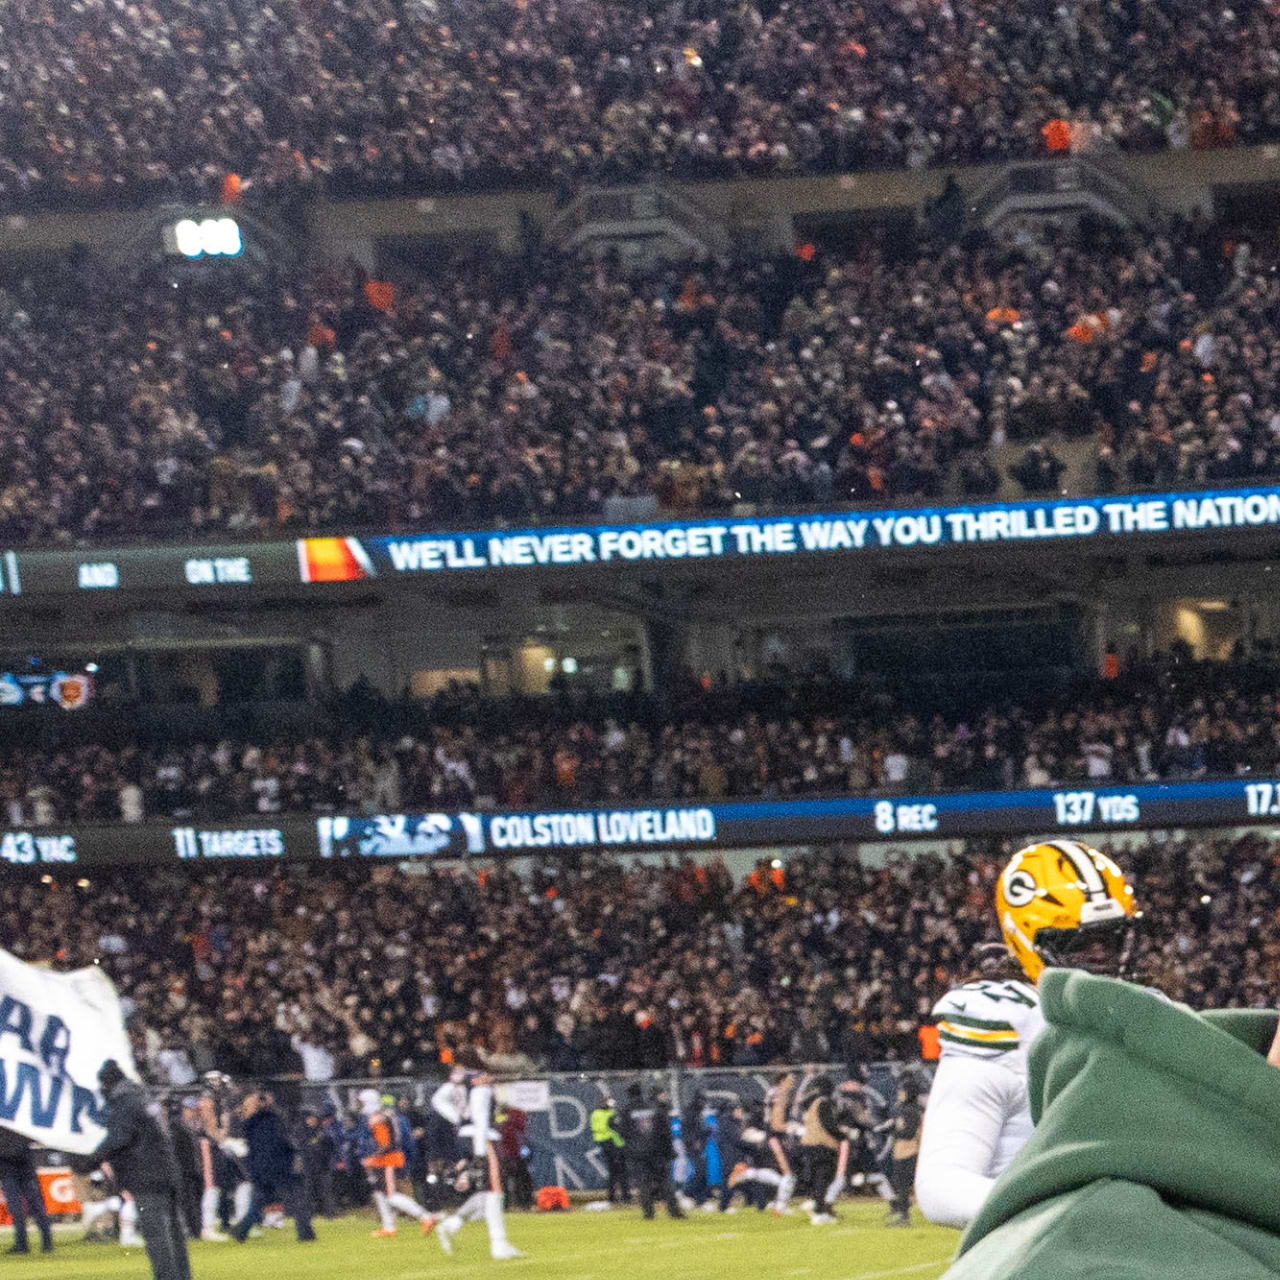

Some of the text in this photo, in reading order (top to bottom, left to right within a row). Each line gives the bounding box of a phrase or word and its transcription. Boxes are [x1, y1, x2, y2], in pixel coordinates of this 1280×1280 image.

[388, 538, 487, 570] WE'LL
[489, 533, 597, 565] NEVER
[600, 526, 727, 560] FORGET
[731, 523, 798, 553] THE
[801, 519, 869, 551] WAY
[872, 514, 943, 547] YOU
[945, 505, 1100, 542] THRILLED
[1103, 501, 1168, 533] THE
[874, 800, 939, 834] 8 REC
[1053, 792, 1140, 825] 137 YDS
[199, 829, 285, 857] TARGETS
[490, 809, 716, 848] COLSTON LOVELAND
